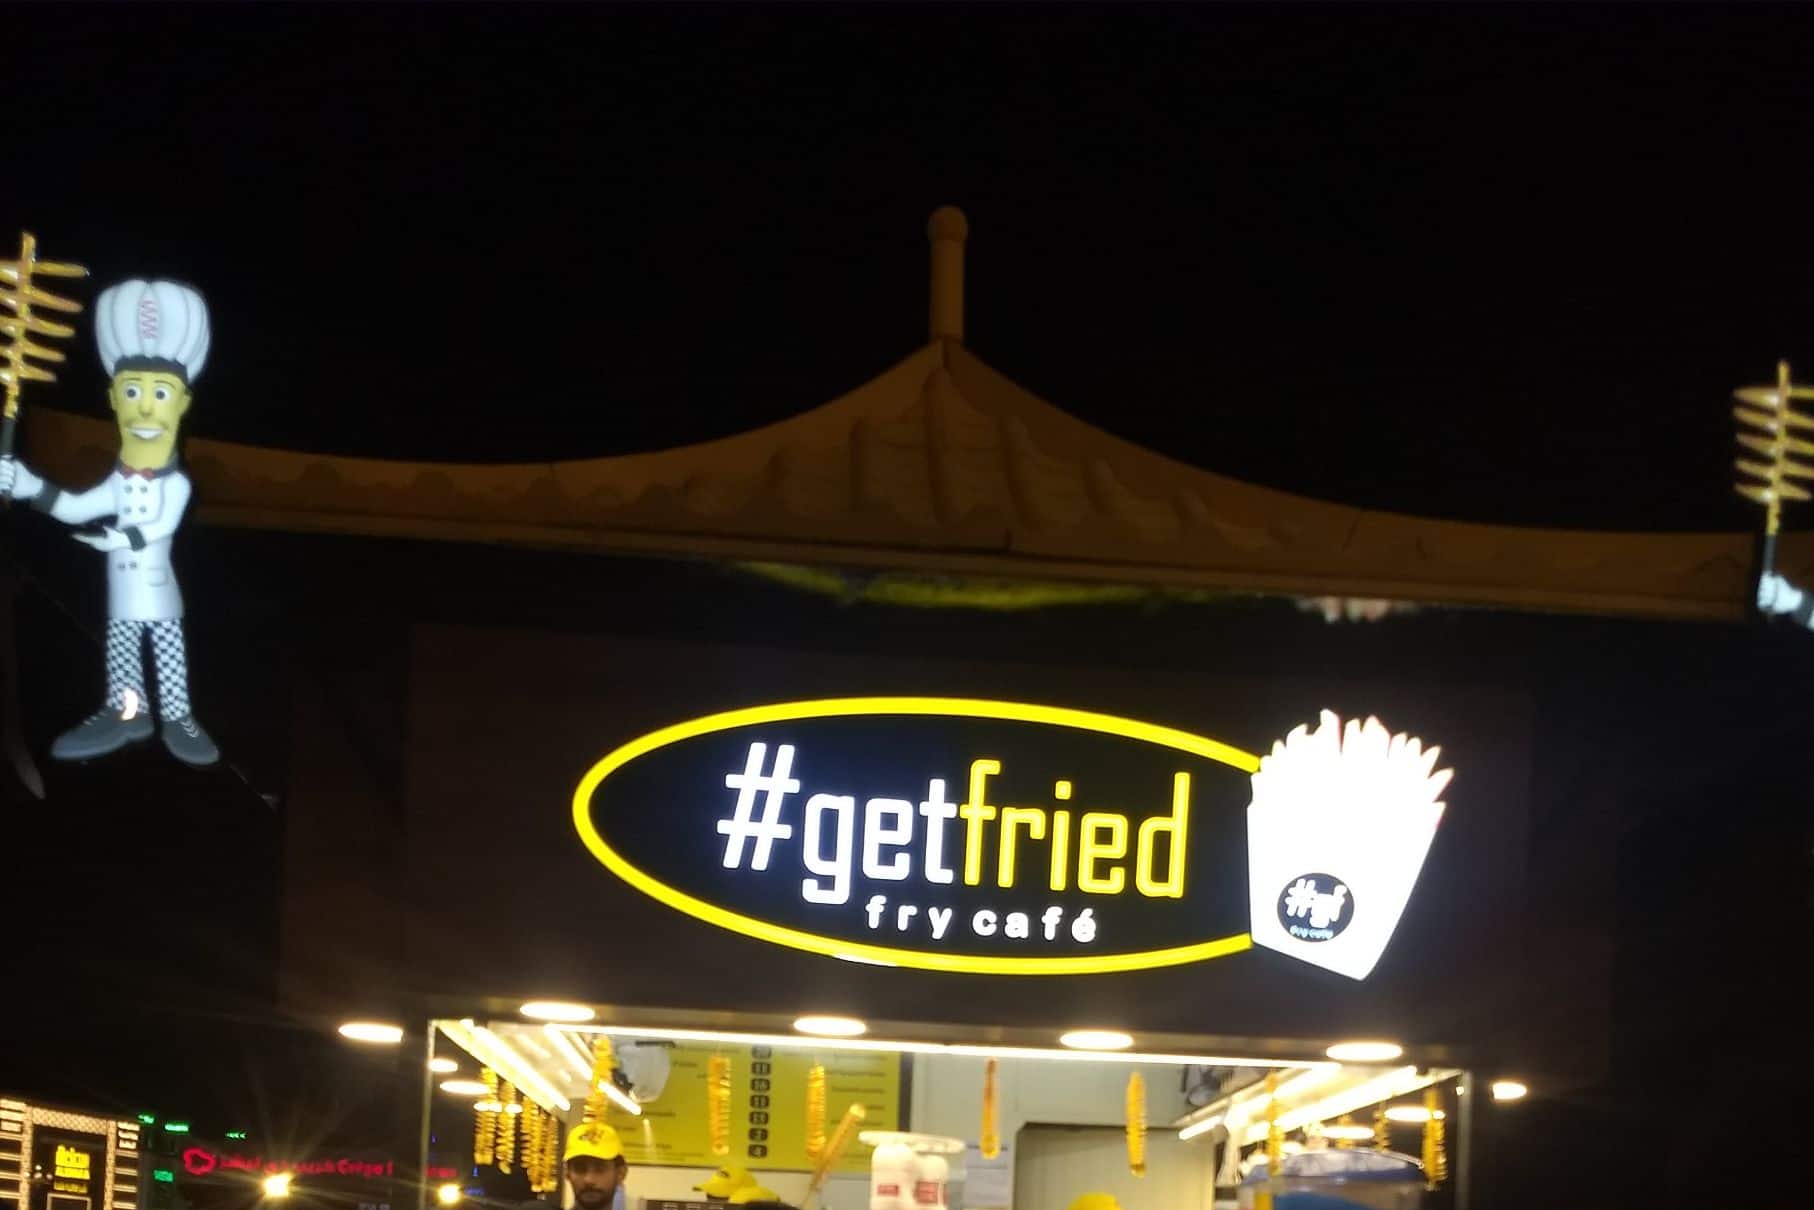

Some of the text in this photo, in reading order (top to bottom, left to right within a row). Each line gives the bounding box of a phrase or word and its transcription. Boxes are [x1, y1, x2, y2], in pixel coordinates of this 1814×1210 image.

[717, 742, 1190, 904] #getfried
[865, 894, 1097, 943] fry café
